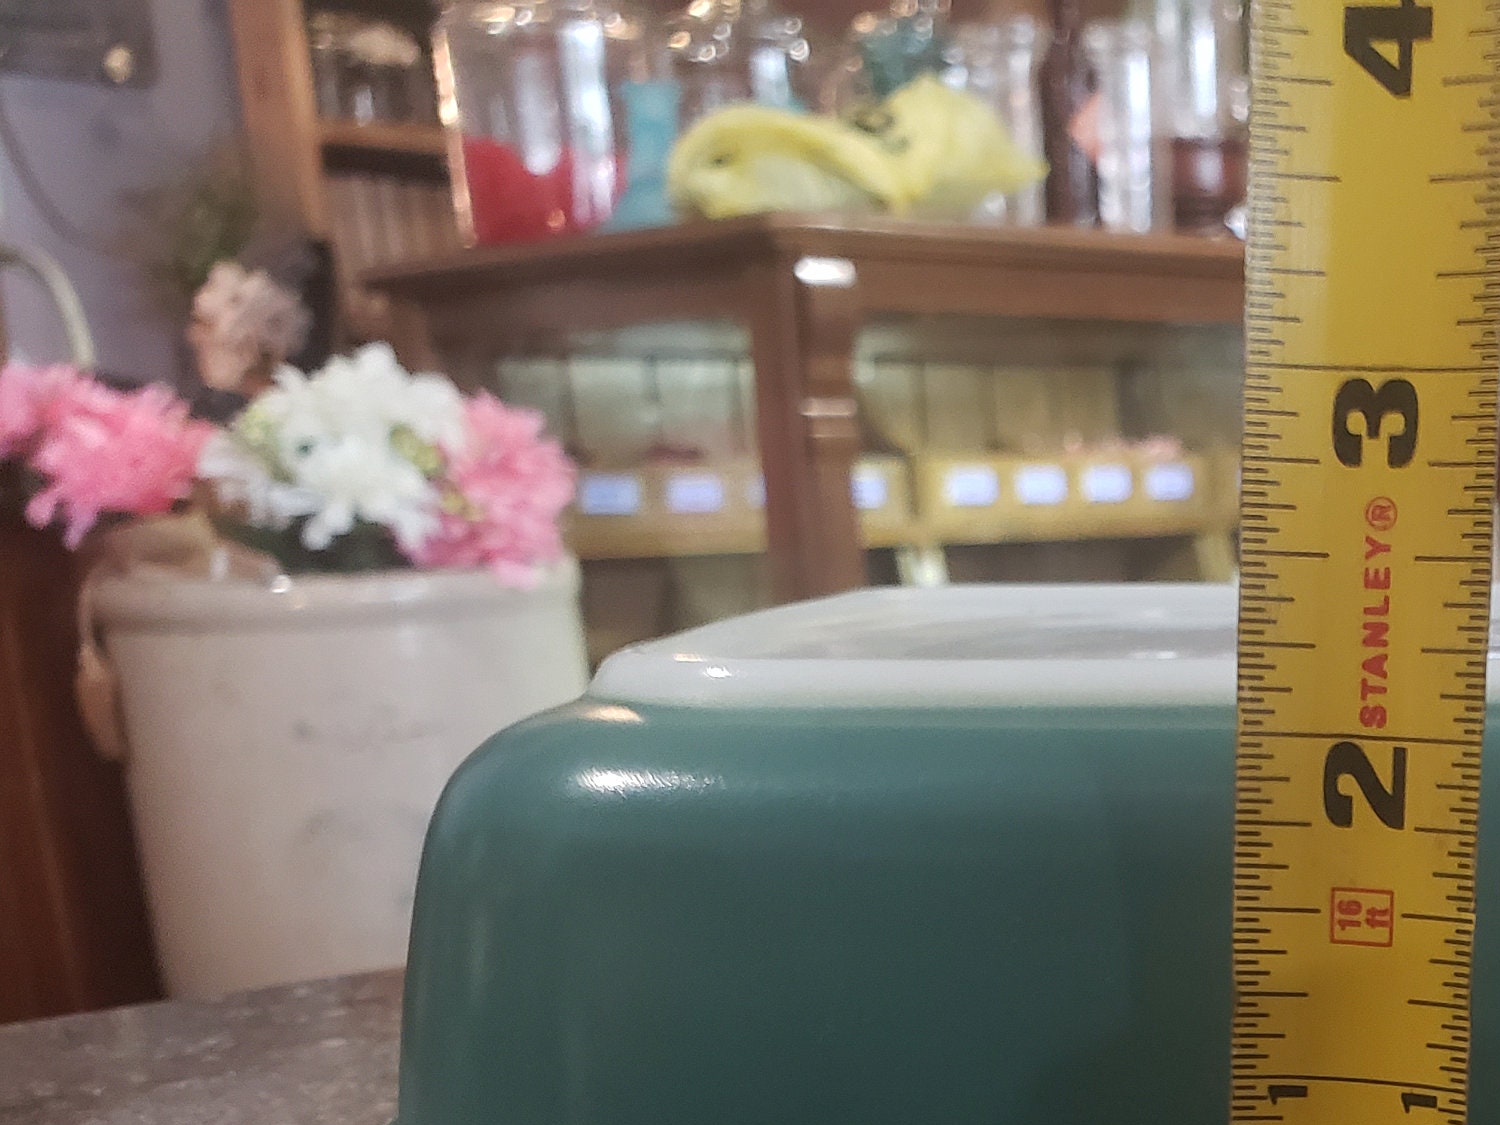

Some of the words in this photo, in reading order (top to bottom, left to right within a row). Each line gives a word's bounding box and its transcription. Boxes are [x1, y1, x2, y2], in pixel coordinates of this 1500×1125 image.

[1343, 0, 1433, 99] 4
[1332, 378, 1419, 469] 3
[1323, 740, 1408, 830] 2
[1338, 899, 1363, 931] 16
[1365, 905, 1392, 930] ft
[1267, 1085, 1308, 1105] 1
[1400, 1092, 1438, 1113] 1
